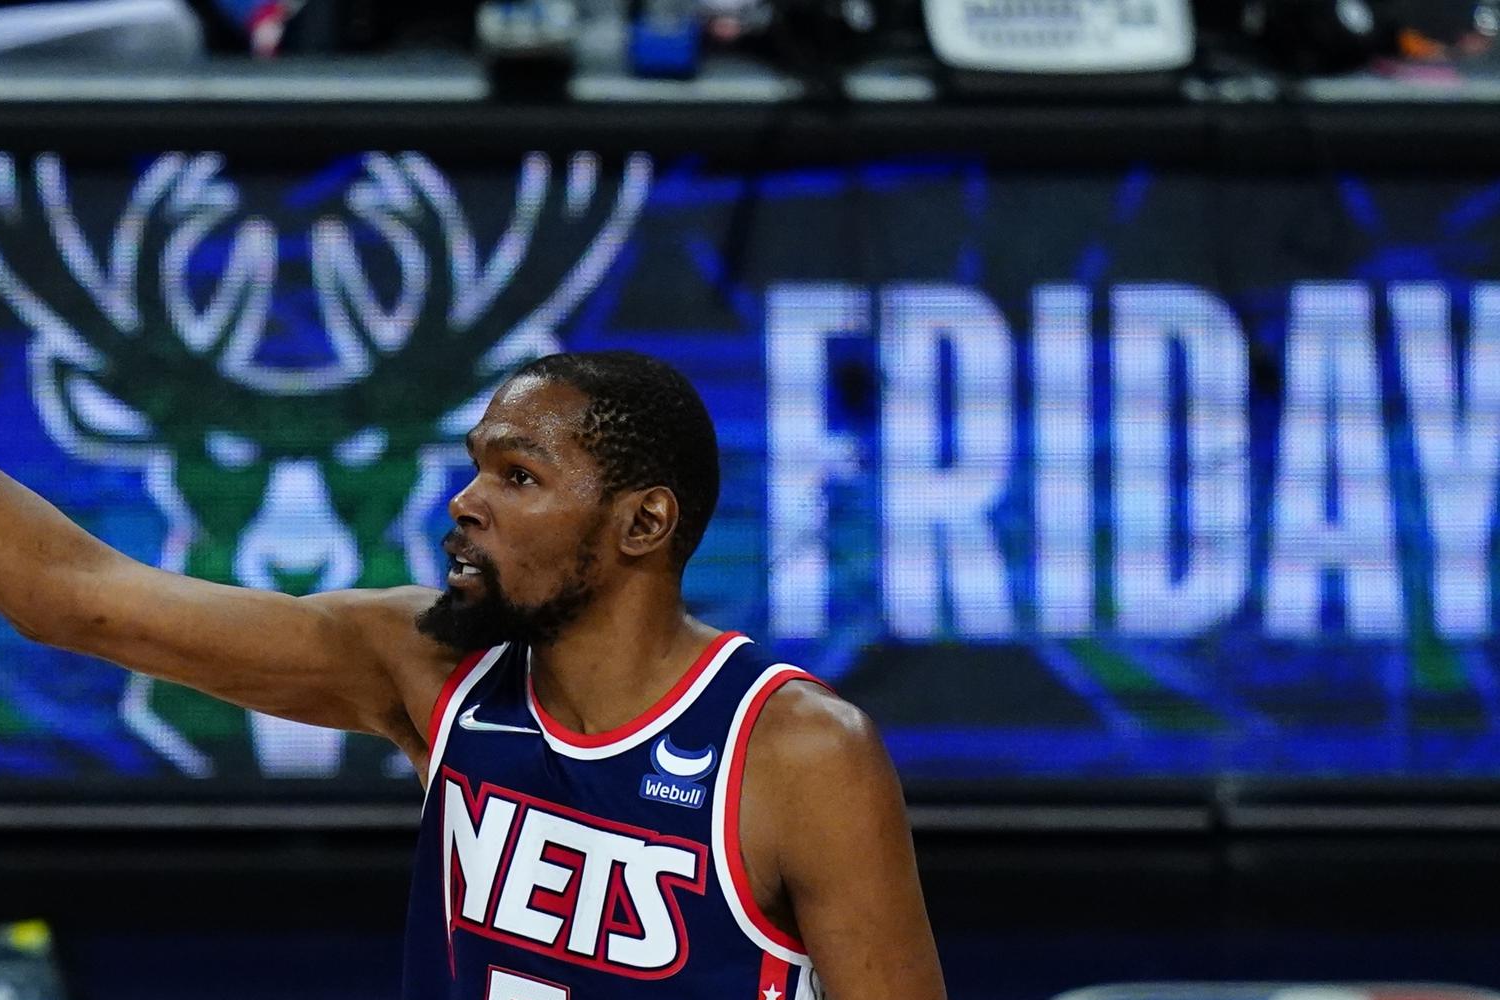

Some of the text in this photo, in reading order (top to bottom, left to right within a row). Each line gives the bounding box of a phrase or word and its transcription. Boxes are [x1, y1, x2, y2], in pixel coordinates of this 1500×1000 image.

[765, 281, 1500, 640] FRIDAY
[442, 766, 708, 980] NETS
[645, 779, 701, 805] Webull
